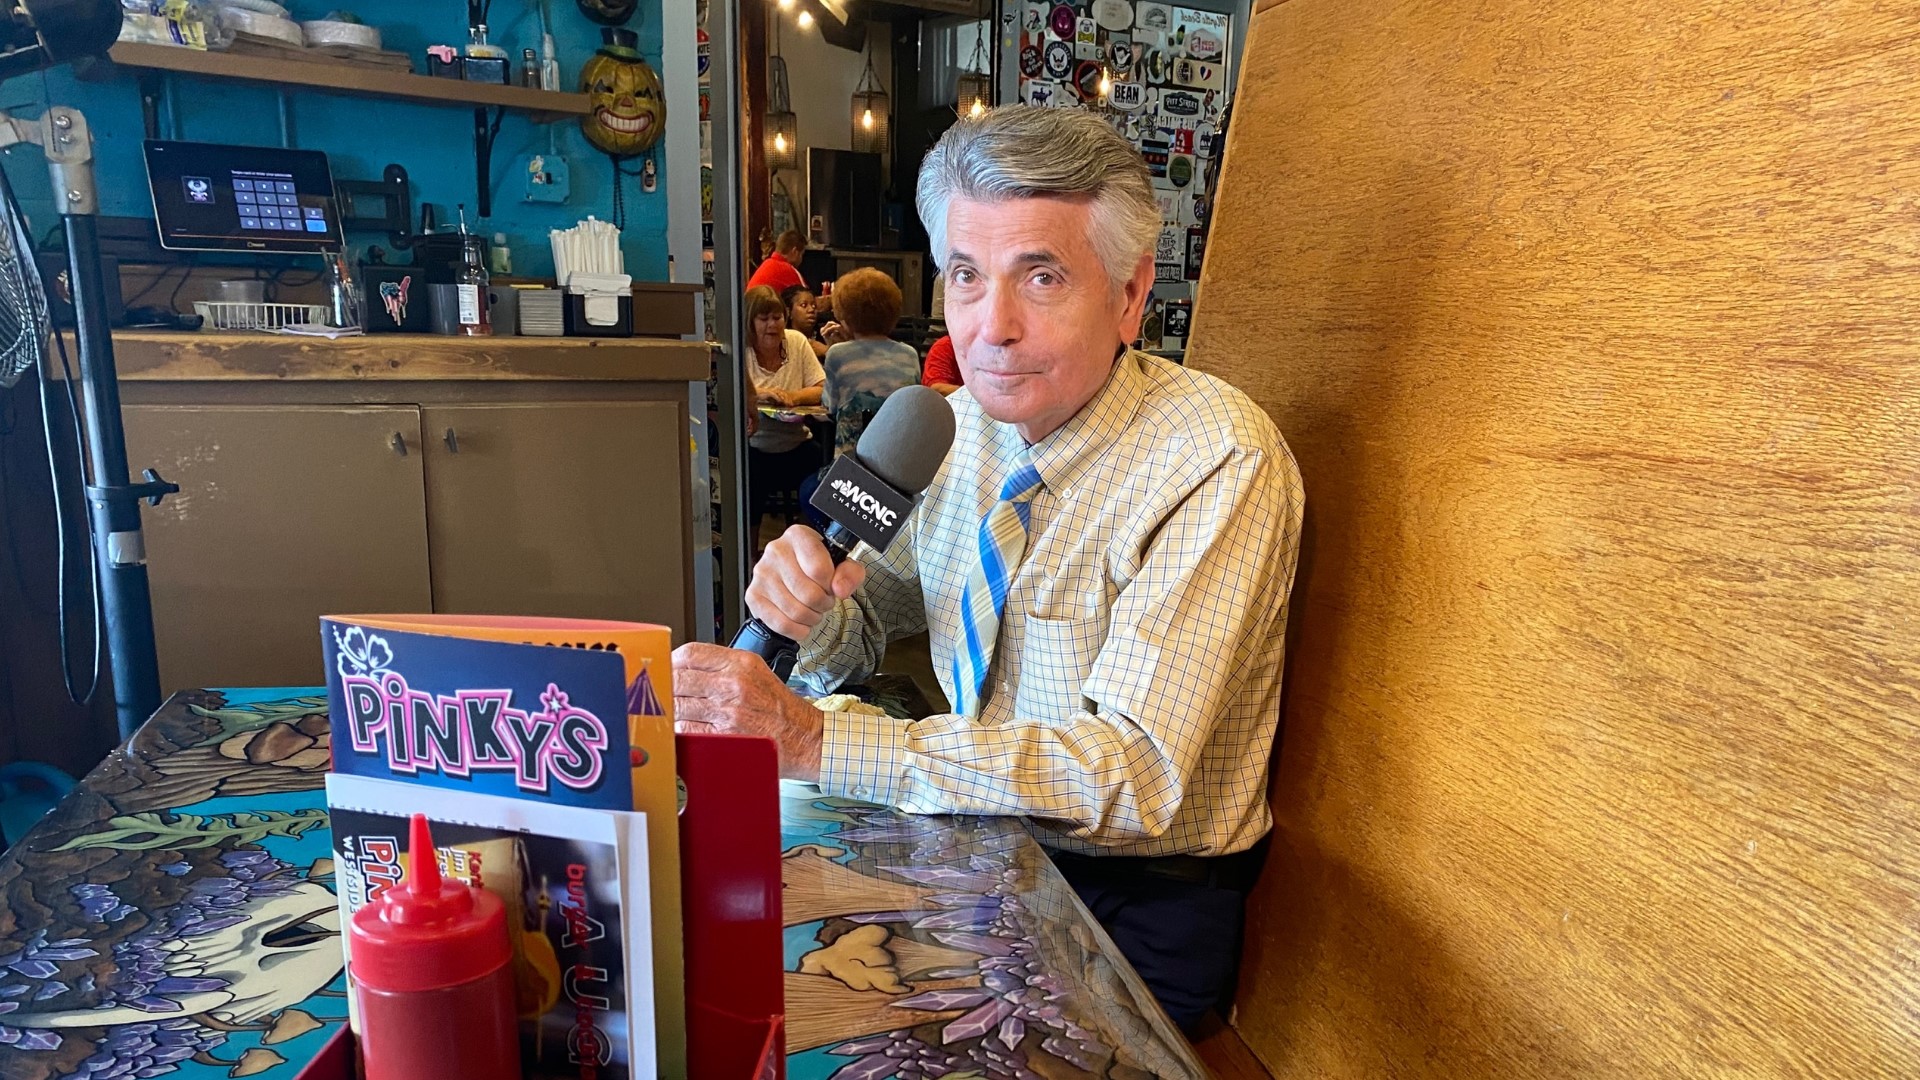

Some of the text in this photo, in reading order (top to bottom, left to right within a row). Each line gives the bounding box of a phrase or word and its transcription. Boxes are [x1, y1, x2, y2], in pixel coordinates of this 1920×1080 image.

[1114, 84, 1139, 101] BEAN
[832, 493, 885, 533] CHARLOTTE
[845, 480, 897, 527] WCNC
[342, 835, 361, 914] WESTSIDE
[450, 847, 466, 872] Jim
